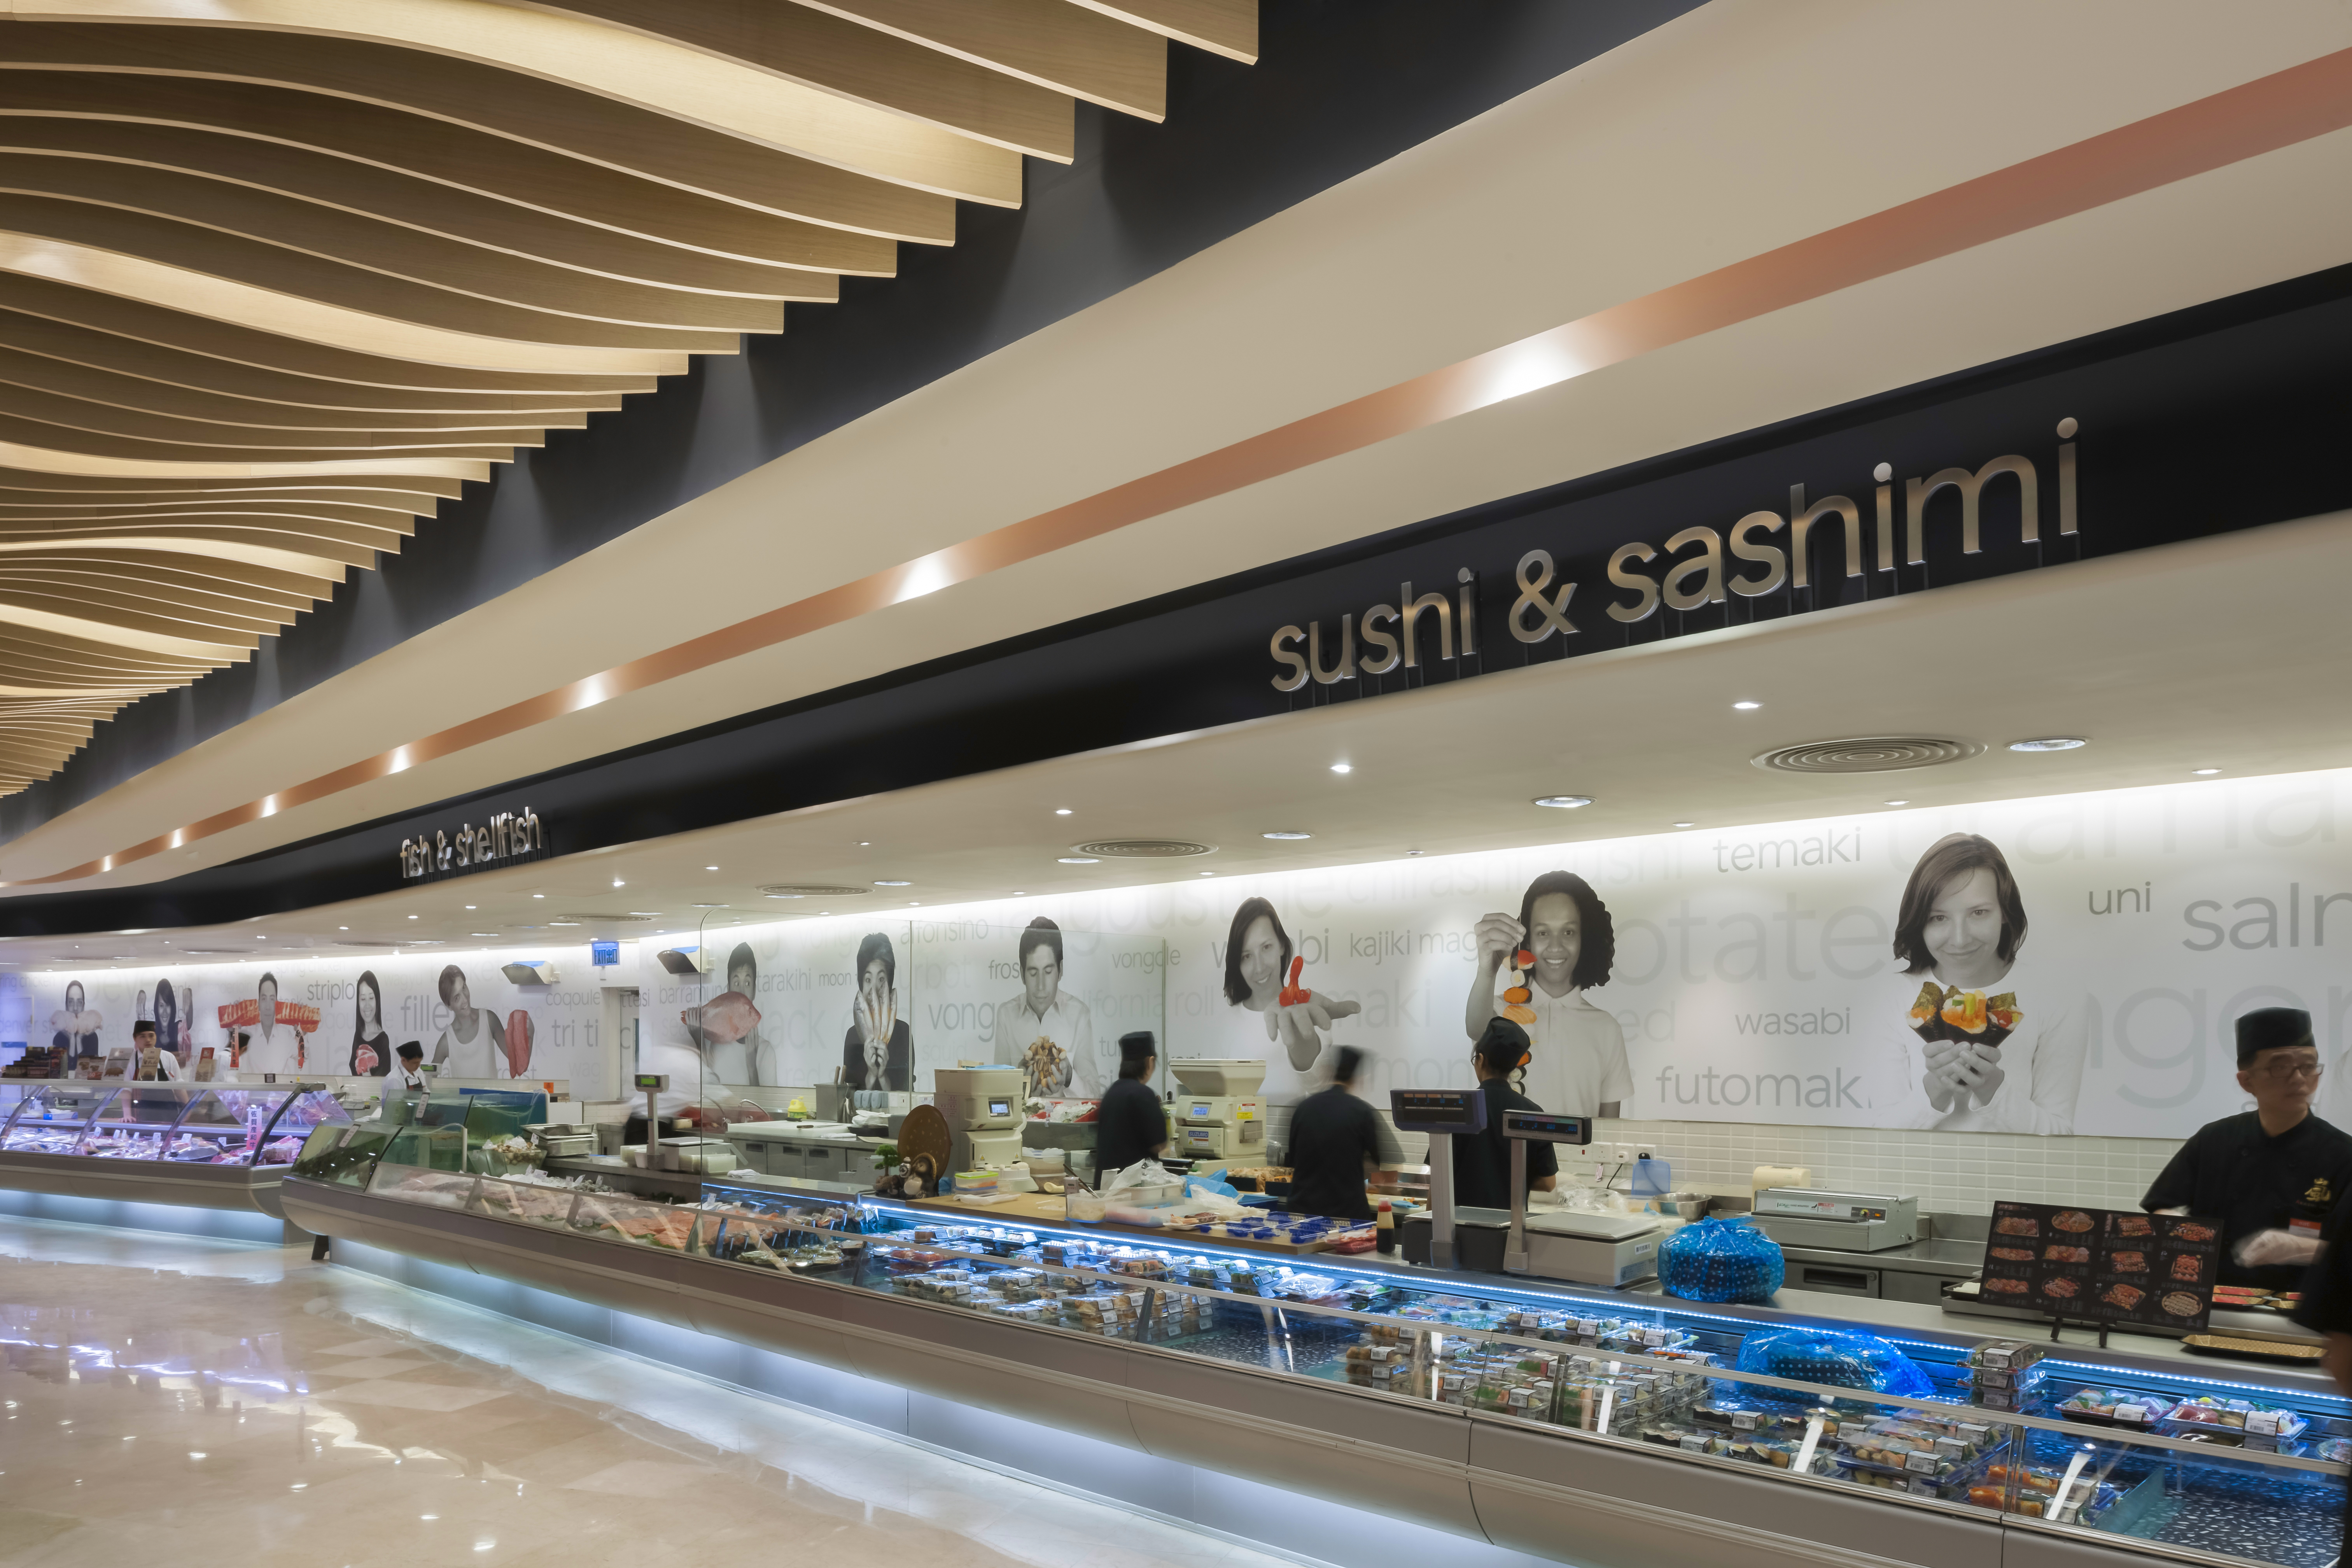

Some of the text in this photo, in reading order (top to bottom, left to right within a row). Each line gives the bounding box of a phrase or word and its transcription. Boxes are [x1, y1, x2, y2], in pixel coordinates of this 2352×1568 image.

[1270, 416, 2081, 692] sushi & sashimi
[400, 806, 544, 878] fish & shellfish
[1712, 826, 1861, 873] temaki
[2088, 881, 2151, 915] uni
[594, 949, 606, 965] EXIT
[607, 948, 618, 964] 出口
[1350, 929, 1411, 966] kajiki
[1418, 933, 1479, 962] mag
[756, 968, 852, 993] tarakihi moon
[988, 959, 1020, 980] fros
[306, 978, 356, 1008] striplo
[1174, 985, 1214, 1017] roll
[551, 1019, 575, 1047] tri
[928, 1001, 996, 1043] vong
[1734, 1007, 1851, 1036] wasabi
[1656, 1066, 1872, 1110] futomak
